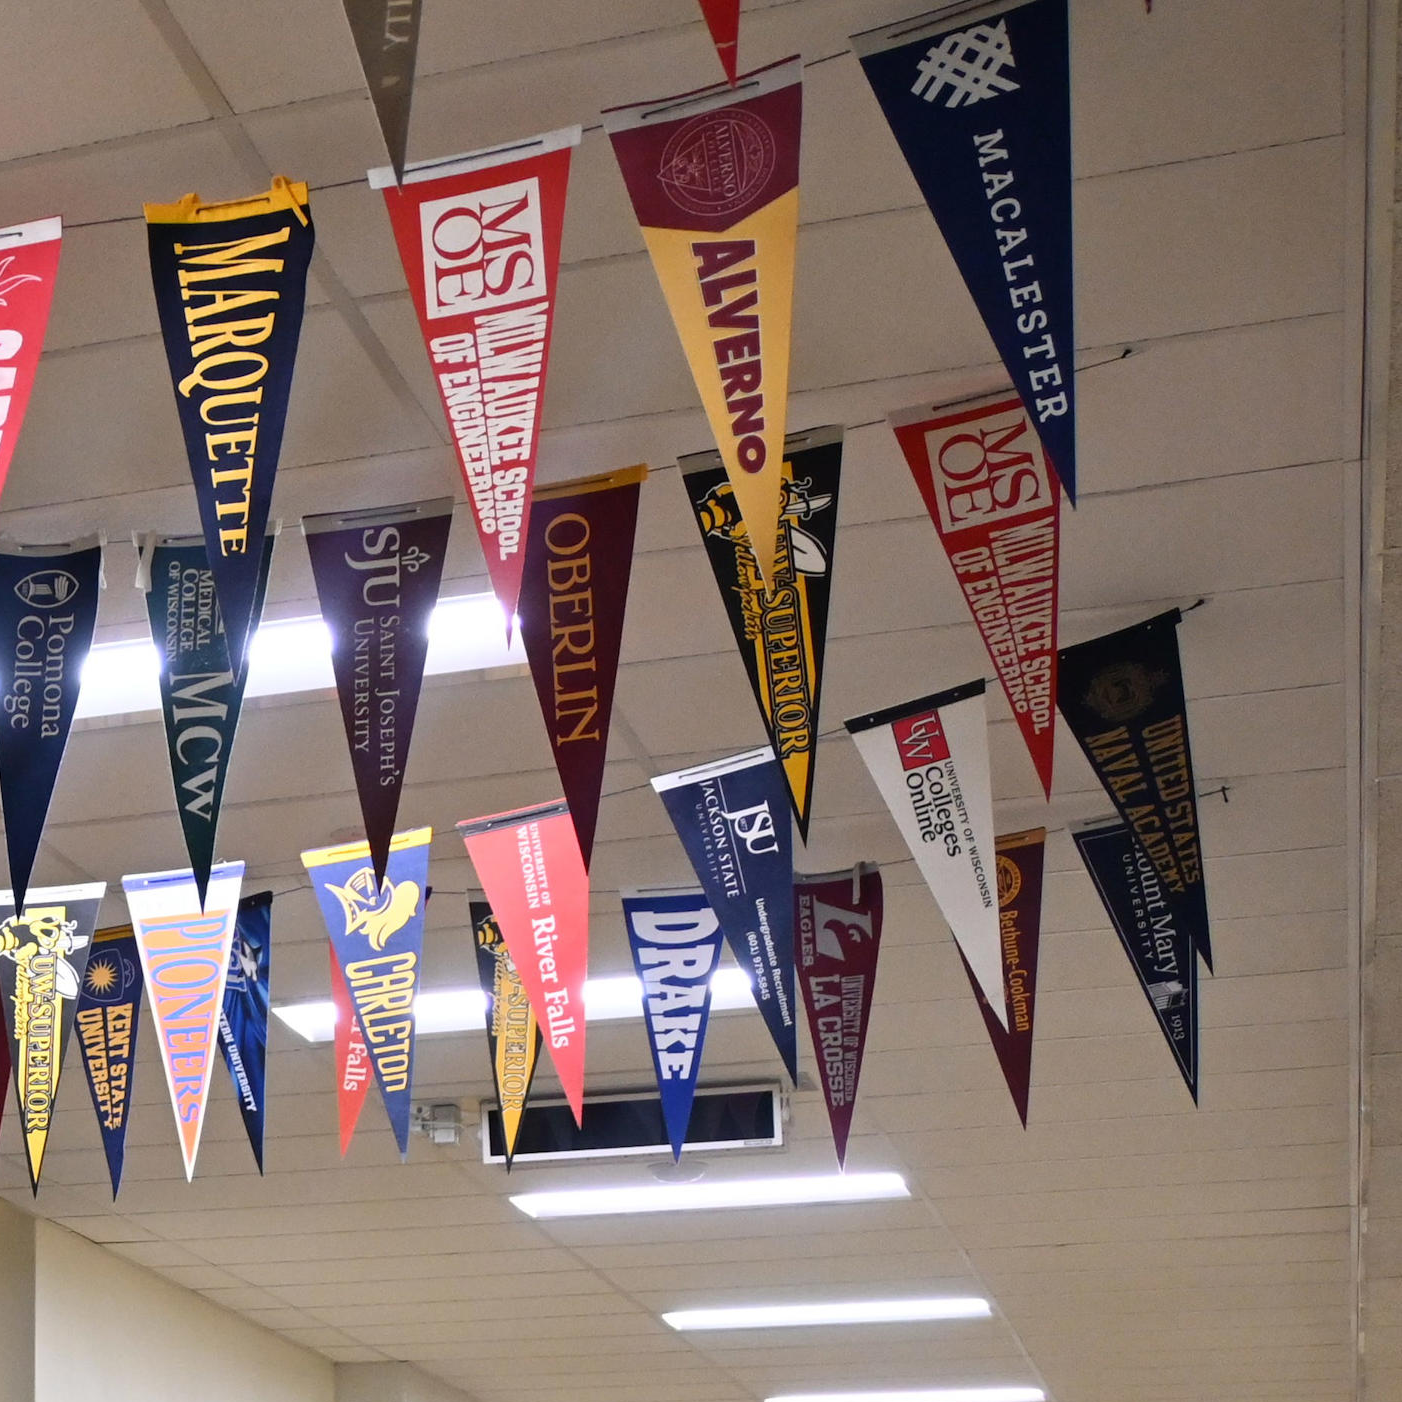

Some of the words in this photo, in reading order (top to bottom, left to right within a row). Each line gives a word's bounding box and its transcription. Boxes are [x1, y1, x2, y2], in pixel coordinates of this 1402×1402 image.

[974, 129, 1070, 422] MACALESTER
[430, 332, 477, 365] OF
[473, 302, 549, 465] MILWAUKEE
[690, 239, 767, 474] ALVERNO
[173, 226, 291, 557] MARQUETTE
[440, 371, 497, 534] ENGINEERING
[494, 466, 527, 560] SCHOOL
[168, 560, 181, 581] OF
[344, 526, 400, 609] SJU
[951, 545, 991, 575] OF
[988, 516, 1057, 656] MILWAUKEE
[179, 568, 200, 654] COLLEGE
[198, 569, 216, 650] MEDICAL
[378, 614, 397, 684] SAINT
[543, 512, 600, 747] OBERLIN
[964, 573, 1029, 715] ENGINEERING
[3, 613, 45, 730] College
[41, 611, 76, 739] Pomona
[353, 616, 374, 753] UNIVERSITY
[1016, 653, 1053, 736] SCHOOL
[168, 672, 235, 824] MCW
[377, 688, 399, 787] JOSEPH'S
[902, 713, 938, 761] UW
[1141, 714, 1188, 799] UNITED
[720, 799, 779, 856] JSU
[905, 771, 937, 844] Online
[924, 766, 962, 858] Colleges
[944, 760, 970, 826] UNIVERSITY
[962, 827, 975, 844] OF
[1086, 725, 1138, 803] NAVAL
[1129, 803, 1186, 895] ACADEMY
[515, 825, 540, 910] WISCONSIN
[530, 823, 547, 887] UNIVERSITY
[543, 889, 551, 906] OF
[699, 780, 726, 853] JACKSON
[716, 854, 741, 899] STATE
[968, 846, 994, 909] WISCONSIN
[1163, 802, 1201, 884] STATES
[531, 914, 558, 985] River
[746, 930, 759, 956] (601)
[798, 894, 814, 968] EAGLES
[1122, 854, 1155, 962] UNIVERSITY
[1151, 911, 1180, 977] Mary
[631, 907, 719, 1080] DRAKE
[754, 897, 777, 968] Undergraduate
[770, 967, 792, 1027] Recruitment
[809, 975, 842, 1010] LA
[841, 974, 866, 1034] UNIVERSITY
[999, 909, 1030, 1033] Bethune-Cookman
[27, 952, 58, 1133] UW-SUPERIOR
[105, 1002, 134, 1059] KENT
[139, 909, 231, 1125] PIONEERS
[344, 951, 417, 1094] CARLETON
[543, 989, 570, 1050] Falls
[844, 1036, 859, 1048] OF
[76, 1007, 114, 1131] UNIVERSITY
[107, 1062, 128, 1130] STATE
[227, 1043, 258, 1113] UNIVERSITY
[342, 1037, 368, 1093] Falls
[817, 1015, 845, 1108] CROSSE
[844, 1051, 857, 1103] WISCONSIN
